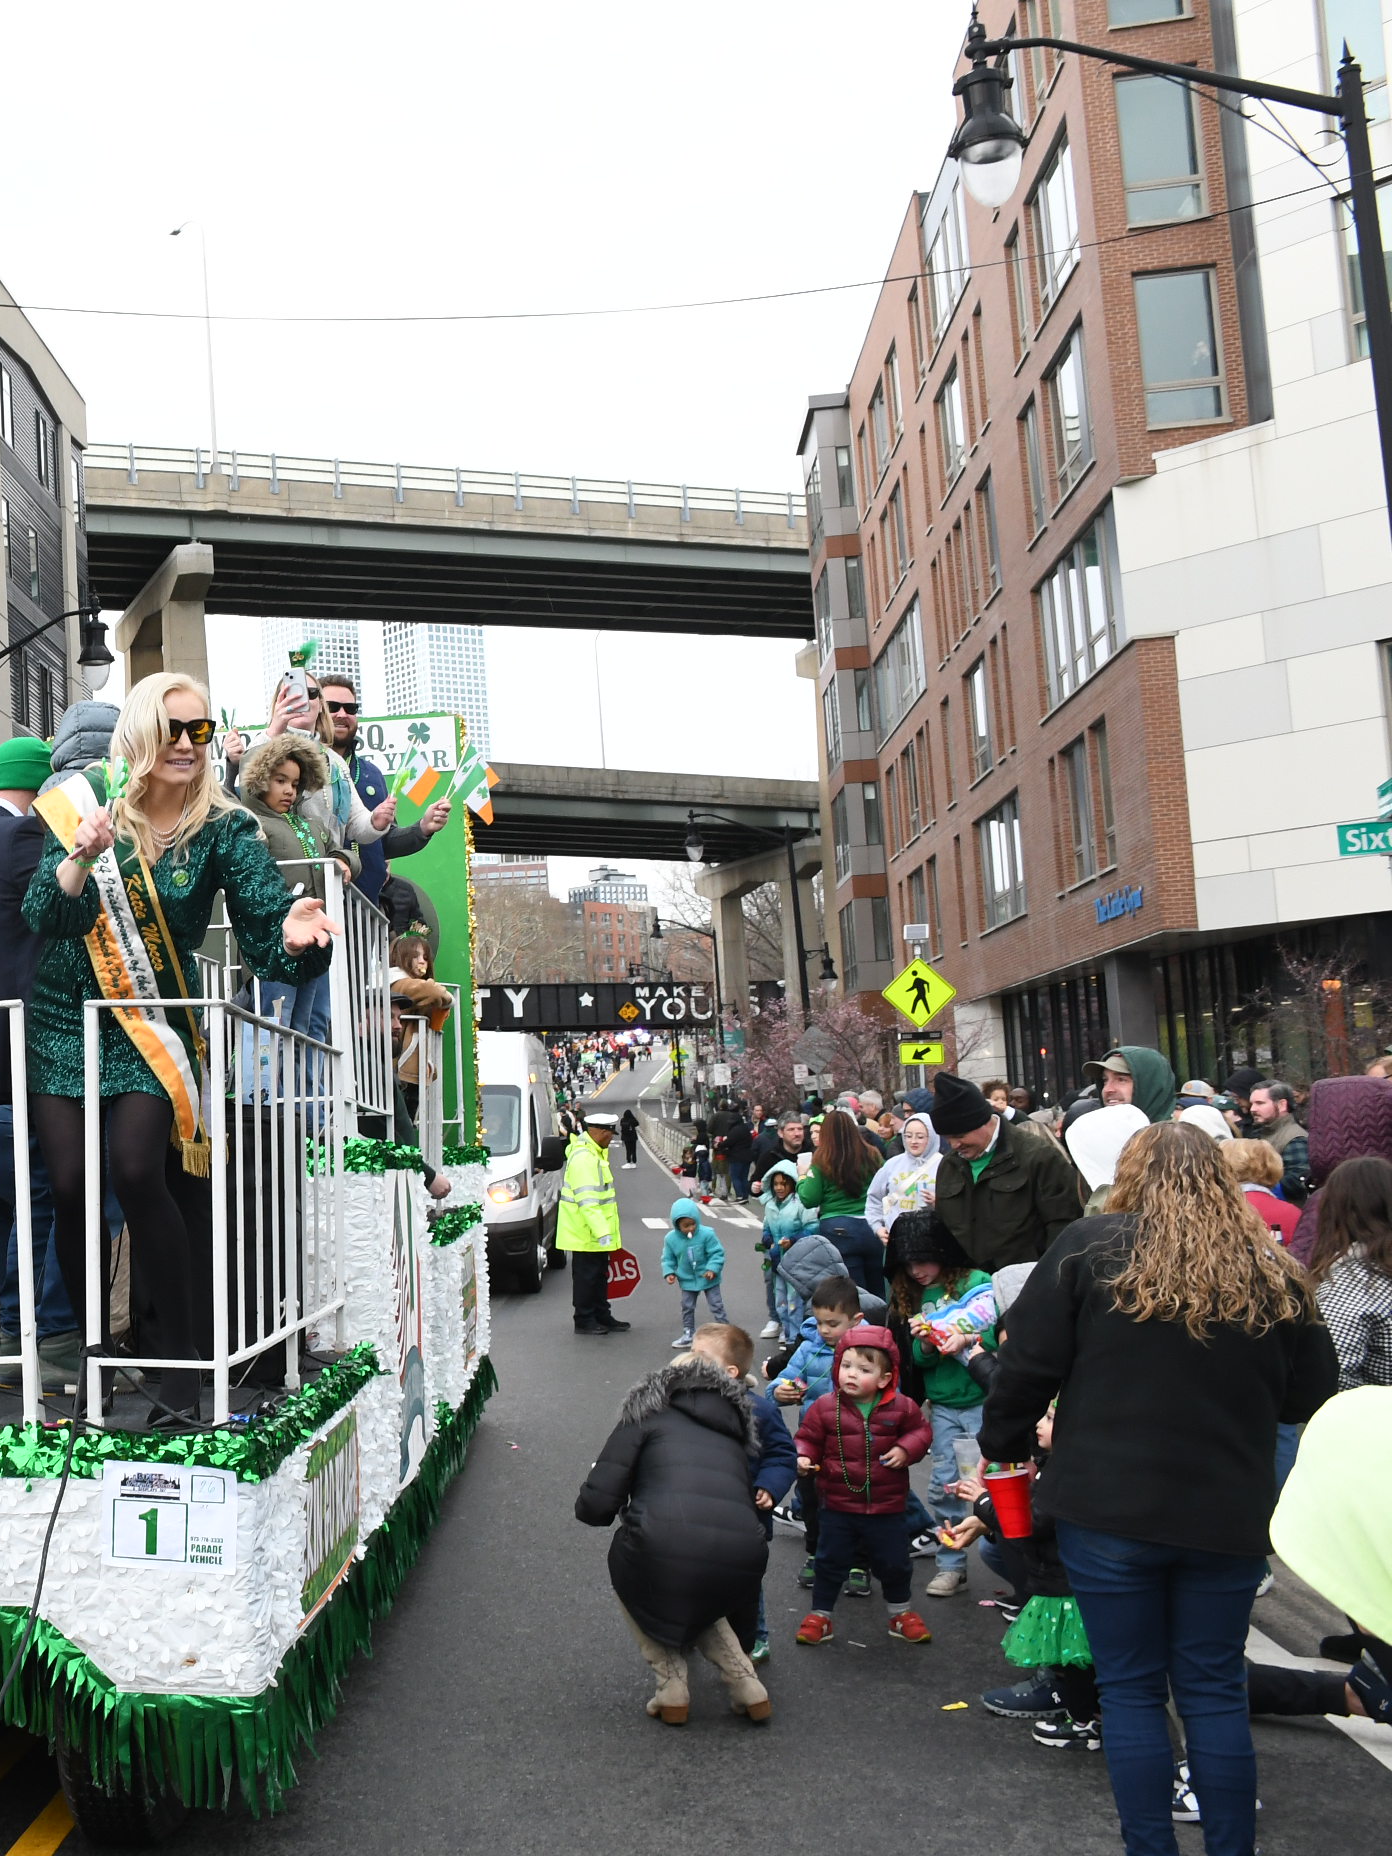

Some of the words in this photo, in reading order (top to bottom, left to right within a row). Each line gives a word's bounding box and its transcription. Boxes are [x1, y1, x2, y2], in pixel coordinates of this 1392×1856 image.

[103, 877, 135, 957] Irishwoman
[124, 873, 148, 919] Katie
[141, 922, 164, 972] Mocco
[128, 959, 146, 972] of
[108, 967, 122, 989] Day
[136, 974, 151, 992] the
[636, 985, 705, 997] MAKE
[607, 1258, 638, 1283] ST
[138, 1507, 158, 1555] 1
[190, 1543, 223, 1555] PARADE
[189, 1554, 223, 1565] VEHICLE
